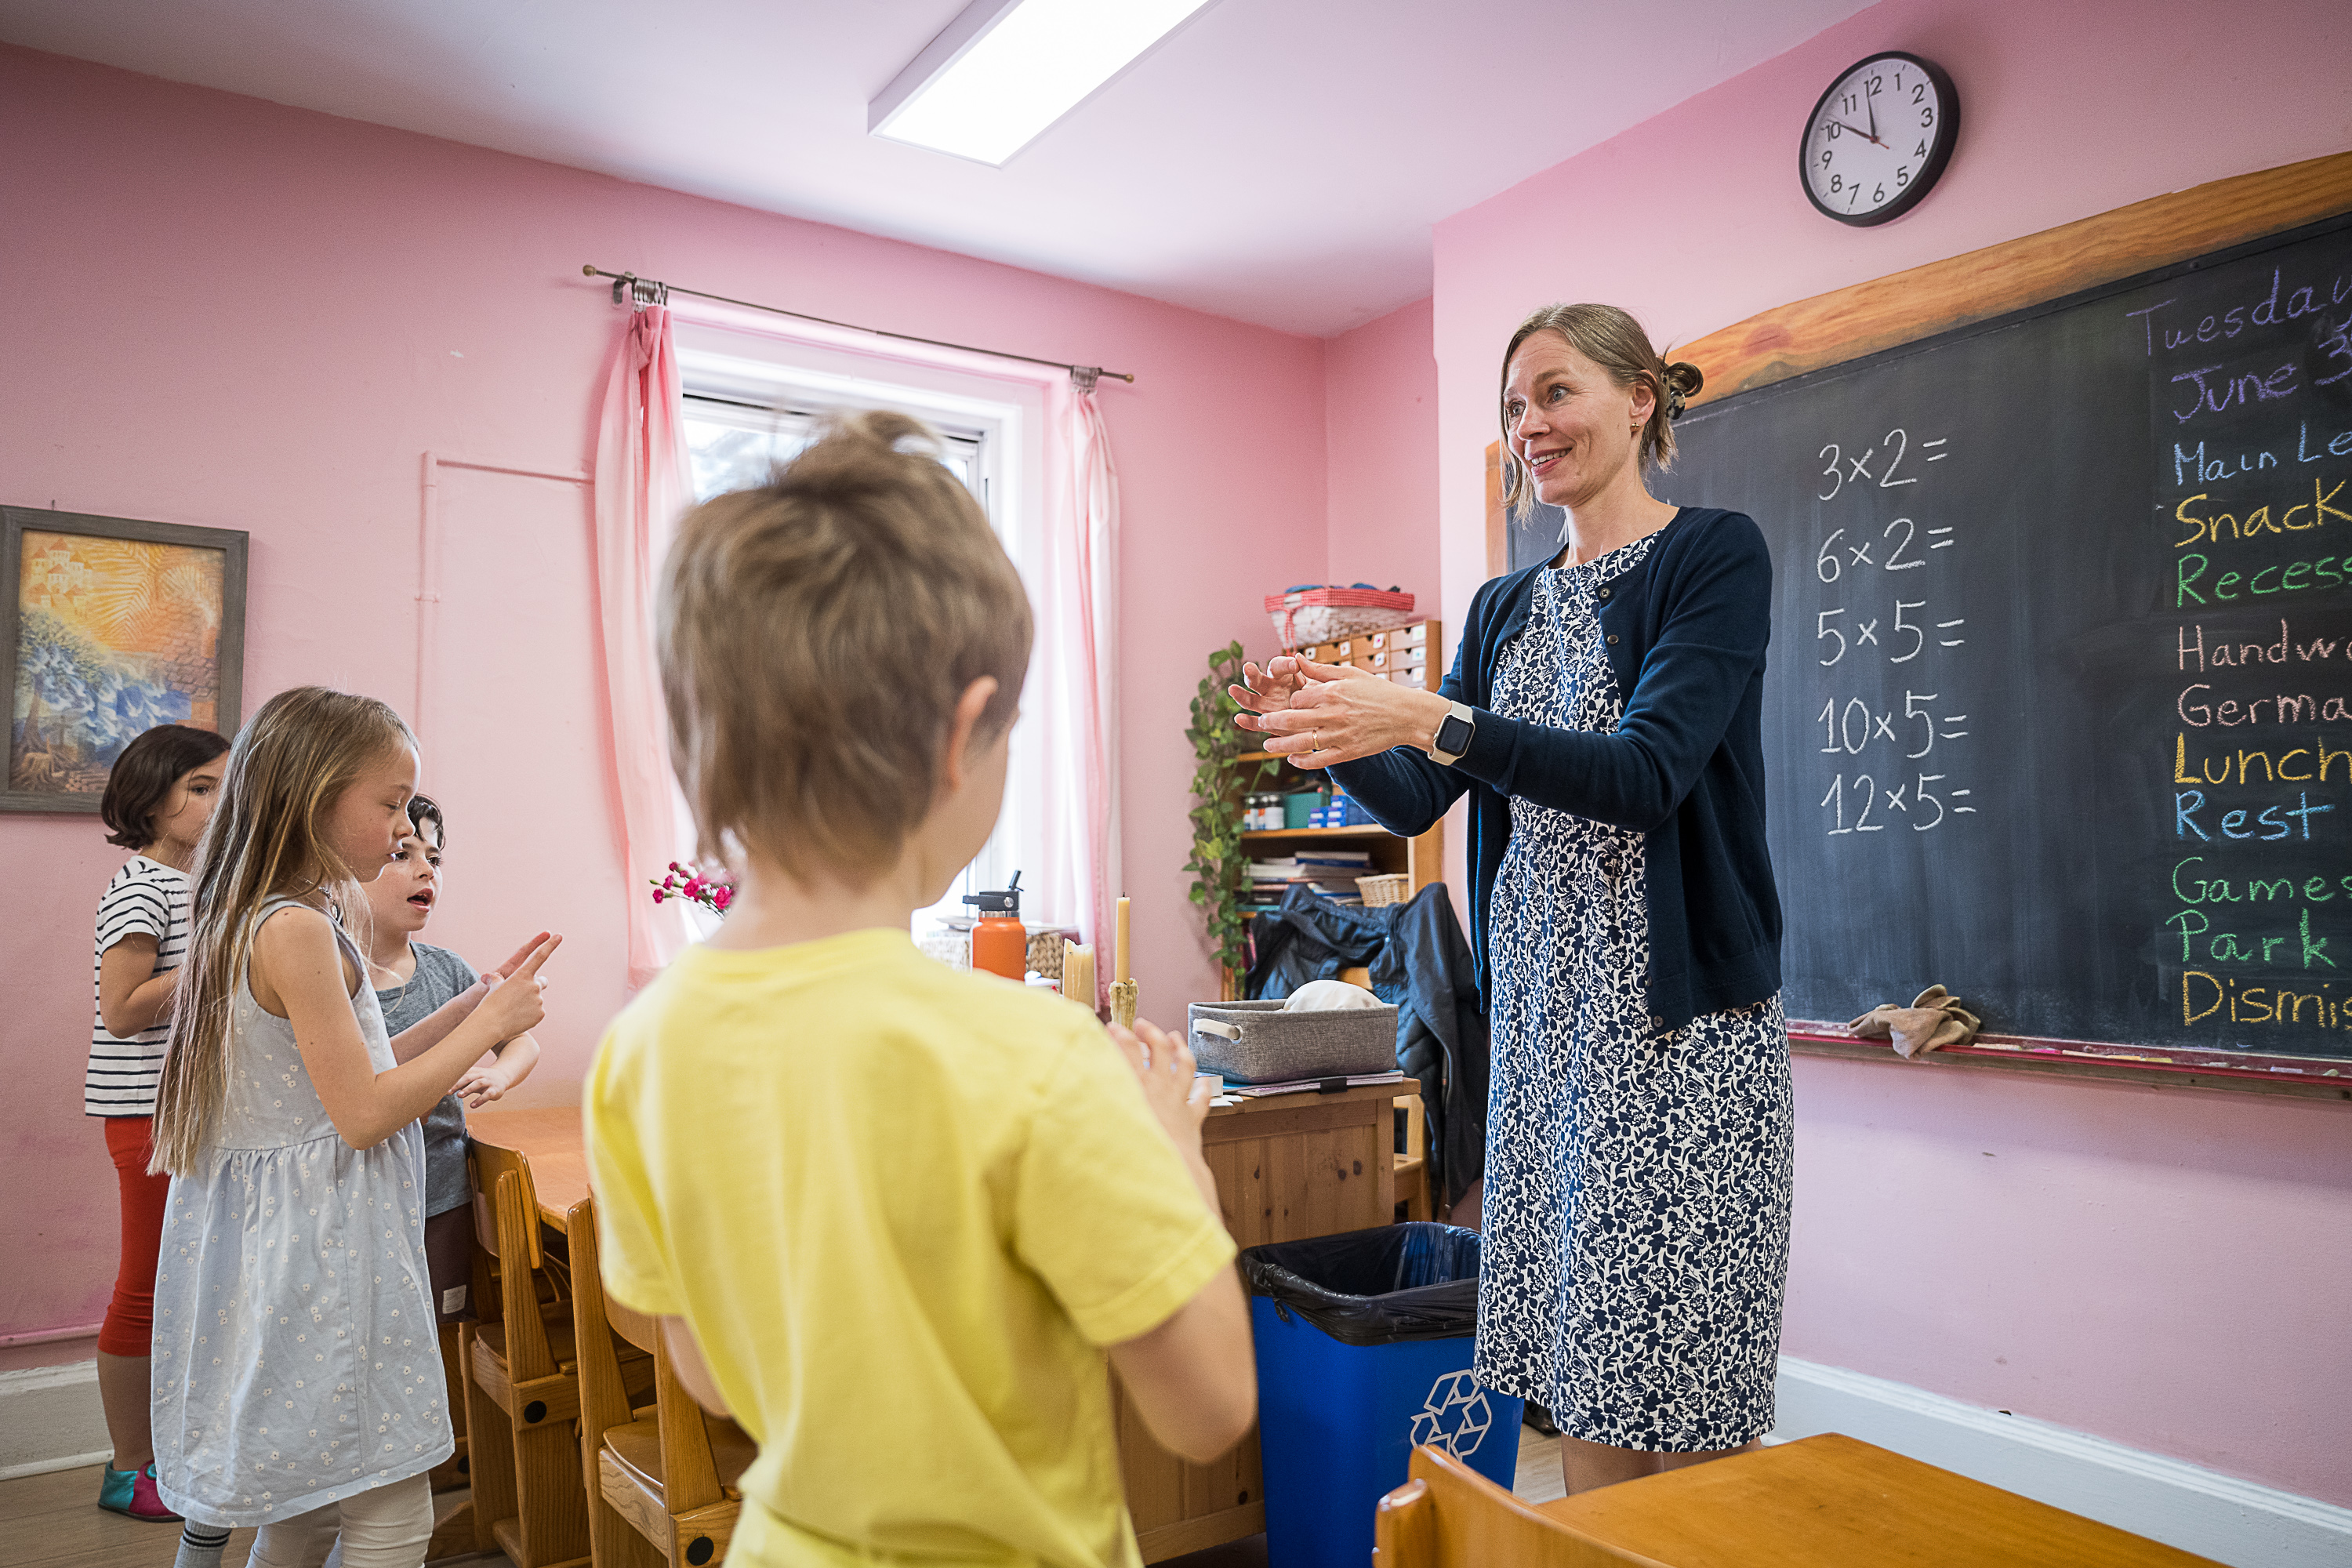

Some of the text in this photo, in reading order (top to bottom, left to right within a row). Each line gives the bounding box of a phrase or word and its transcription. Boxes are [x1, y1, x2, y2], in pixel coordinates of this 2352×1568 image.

[1864, 75, 1882, 97] 12
[1894, 73, 1901, 91] 1
[1842, 93, 1857, 115] 11
[1911, 83, 1925, 105] 2
[1921, 107, 1933, 128] 3
[1824, 121, 1841, 142] 10
[1914, 139, 1927, 158] 4
[1821, 151, 1833, 170] 9
[1831, 174, 1842, 194] 8
[1896, 165, 1908, 187] 5
[1849, 183, 1860, 205] 7
[1872, 182, 1885, 203] 6
[2170, 362, 2299, 425] June
[2173, 441, 2278, 486] Main
[2177, 617, 2352, 673] Handw
[2177, 683, 2352, 728] Germa
[2174, 731, 2352, 785] Lunch
[2175, 789, 2336, 842] Rest
[2165, 906, 2337, 970] Park
